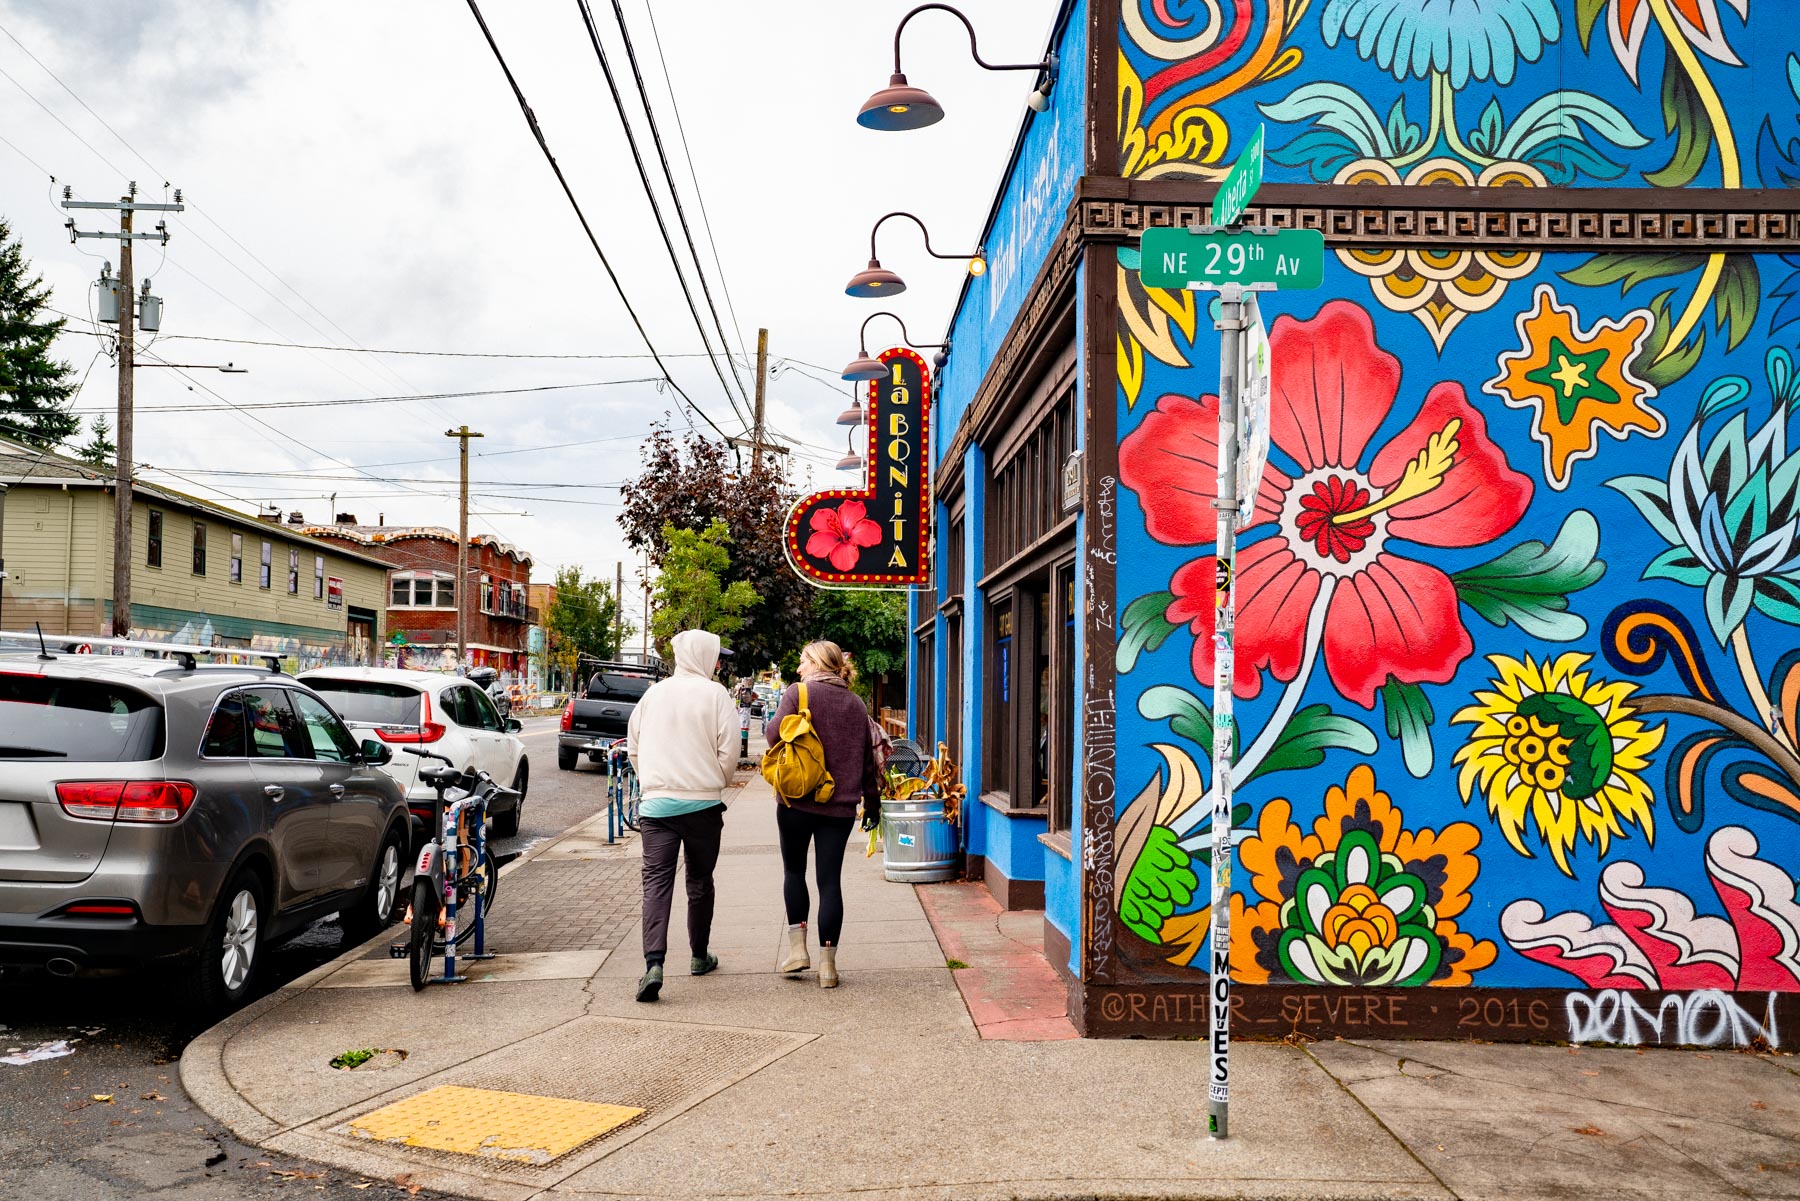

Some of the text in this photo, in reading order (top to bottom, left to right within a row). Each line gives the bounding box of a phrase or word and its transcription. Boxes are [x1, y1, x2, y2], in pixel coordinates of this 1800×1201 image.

[1220, 168, 1248, 226] Alberta
[1163, 242, 1300, 276] NE 29th Av
[1101, 992, 1549, 1029] @RATHR_SEVERE 2016
[1214, 951, 1229, 1082] MOVES
